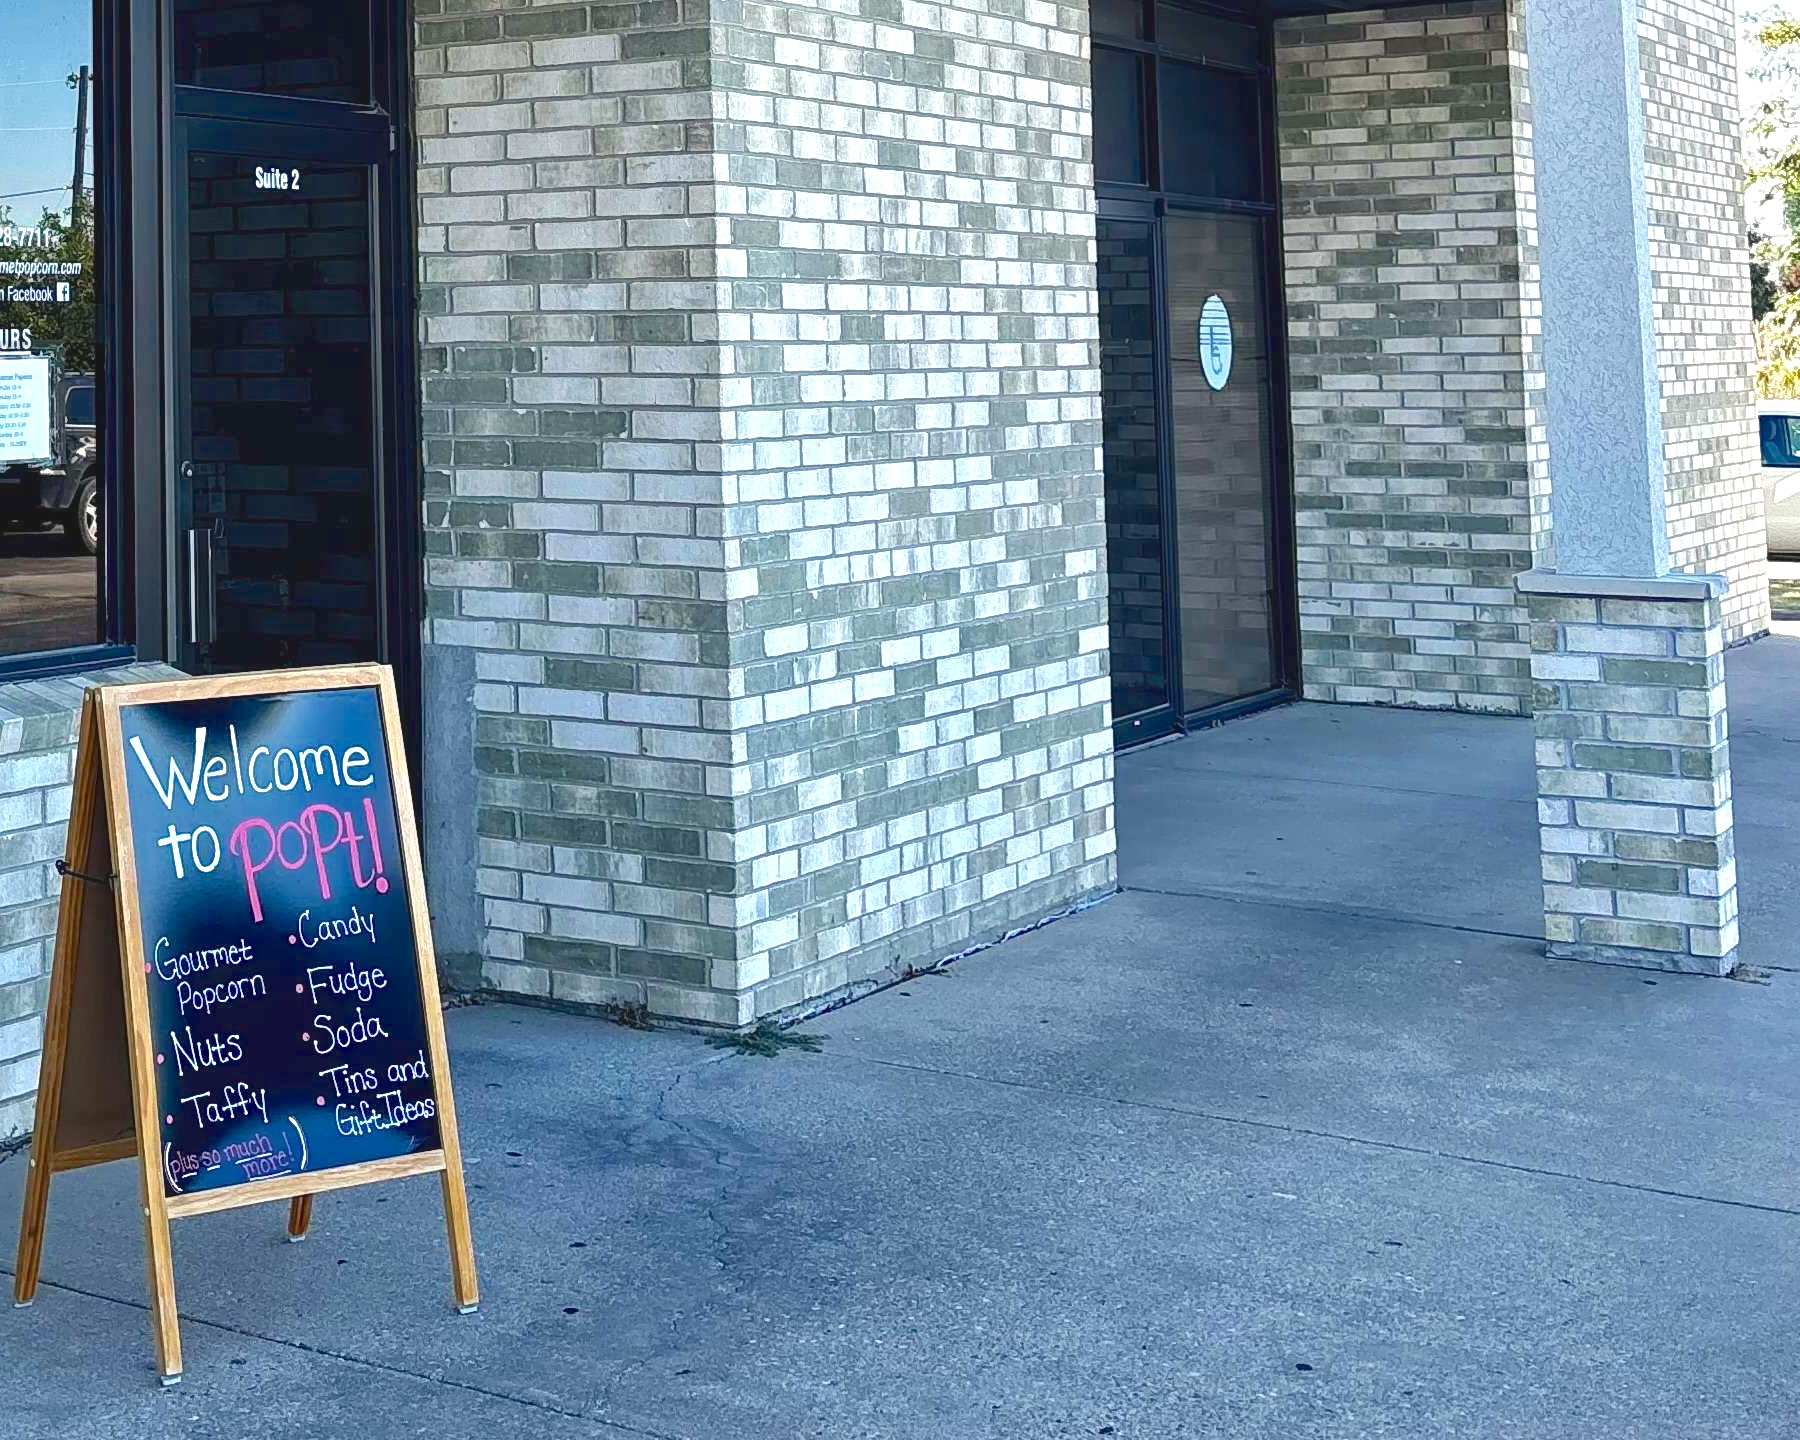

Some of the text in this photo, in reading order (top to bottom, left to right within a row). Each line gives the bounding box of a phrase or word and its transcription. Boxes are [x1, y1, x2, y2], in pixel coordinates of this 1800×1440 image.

[255, 166, 300, 190] Suite 2
[7, 286, 53, 302] Facebook
[130, 724, 374, 810] Welcome
[158, 823, 221, 879] to
[298, 906, 376, 948] Candy
[155, 937, 253, 980] Gourmet
[177, 974, 266, 1015] Popcorn
[307, 962, 388, 1002] Fudge
[171, 1026, 242, 1076] Nuts
[313, 1007, 389, 1054] Soda
[319, 1050, 429, 1097] Tins and
[181, 1082, 268, 1128] Taffy
[336, 1090, 434, 1135] Gift Ideas
[202, 1149, 221, 1168] so
[224, 1133, 272, 1161] much
